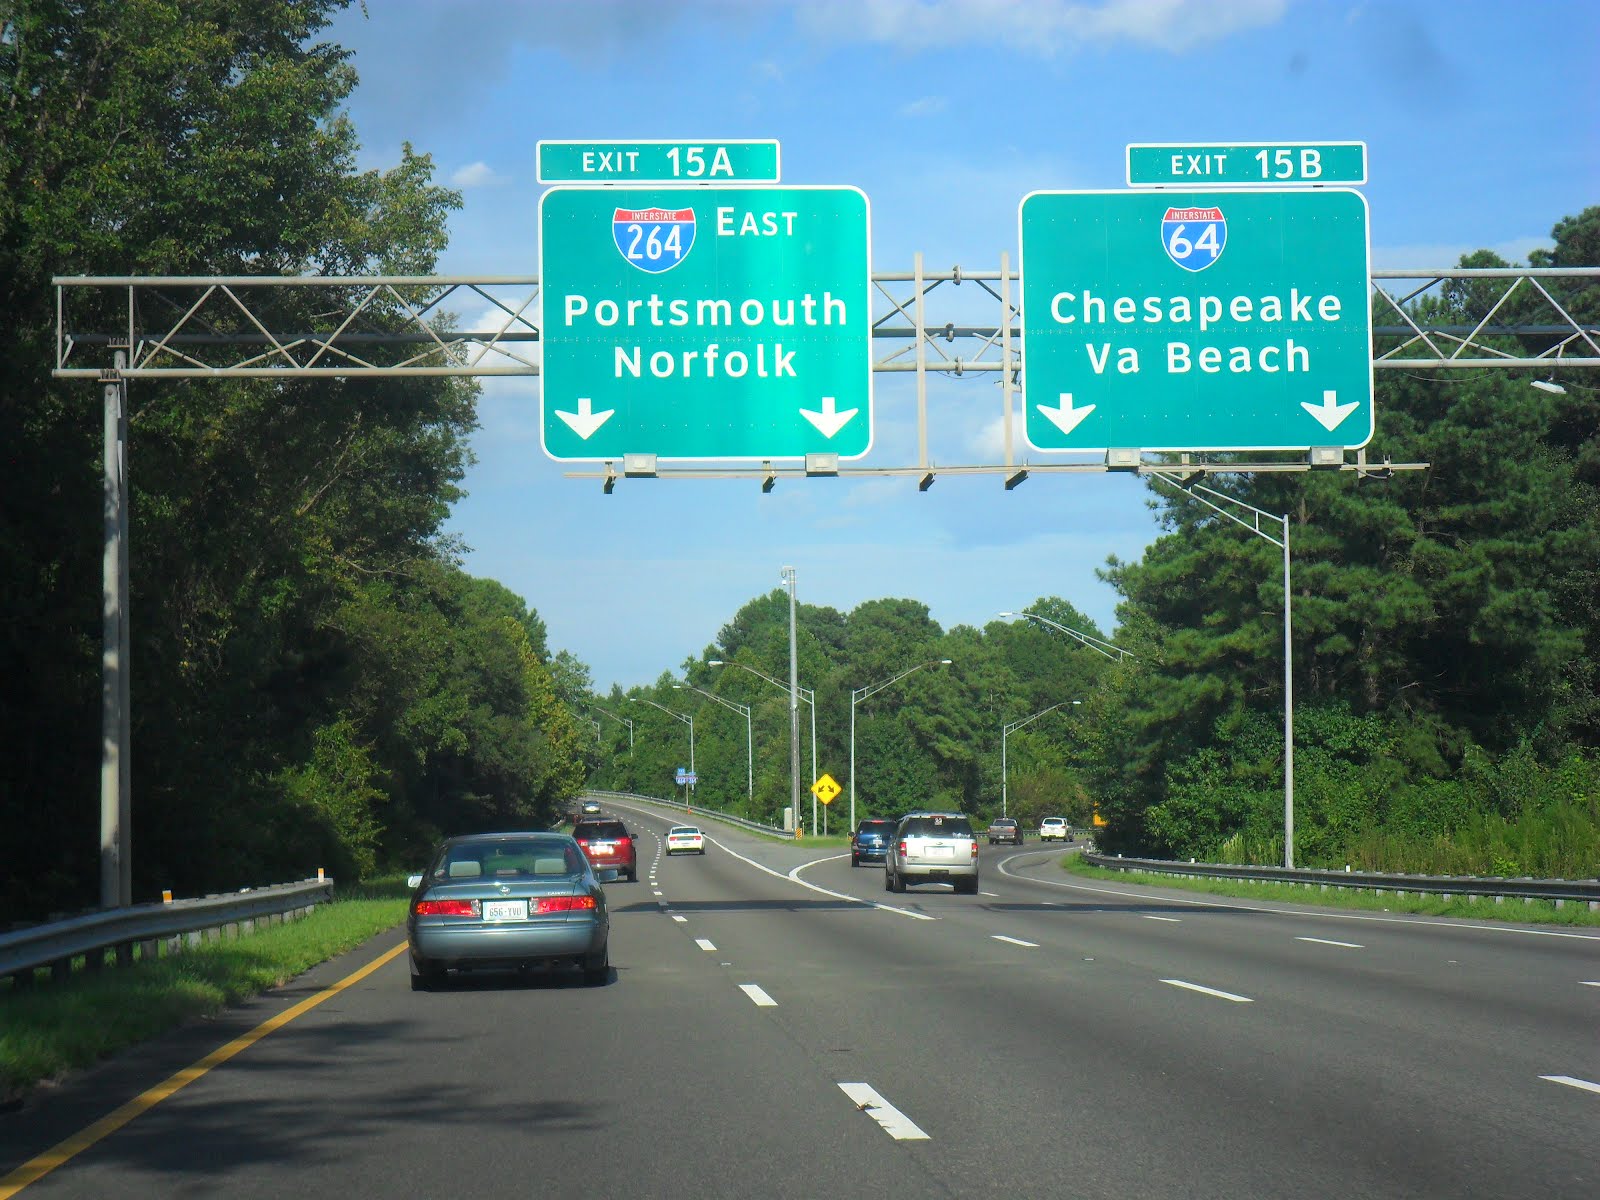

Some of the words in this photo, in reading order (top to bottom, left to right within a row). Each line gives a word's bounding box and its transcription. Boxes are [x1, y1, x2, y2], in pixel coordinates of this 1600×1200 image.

[582, 152, 640, 172] EXIT
[666, 147, 735, 177] 15A
[1171, 154, 1227, 175] EXIT
[1255, 149, 1322, 179] 15B
[631, 212, 677, 221] INTERSTATE
[717, 207, 798, 236] EAST
[1171, 211, 1216, 220] INTERSTATE
[627, 224, 682, 260] 264
[1169, 223, 1220, 259] 64
[564, 292, 847, 326] Portsmouth
[1051, 288, 1342, 331] Chesapeake
[614, 344, 798, 378] Norfolk
[1085, 342, 1140, 374] Va
[1167, 339, 1310, 374] Beach
